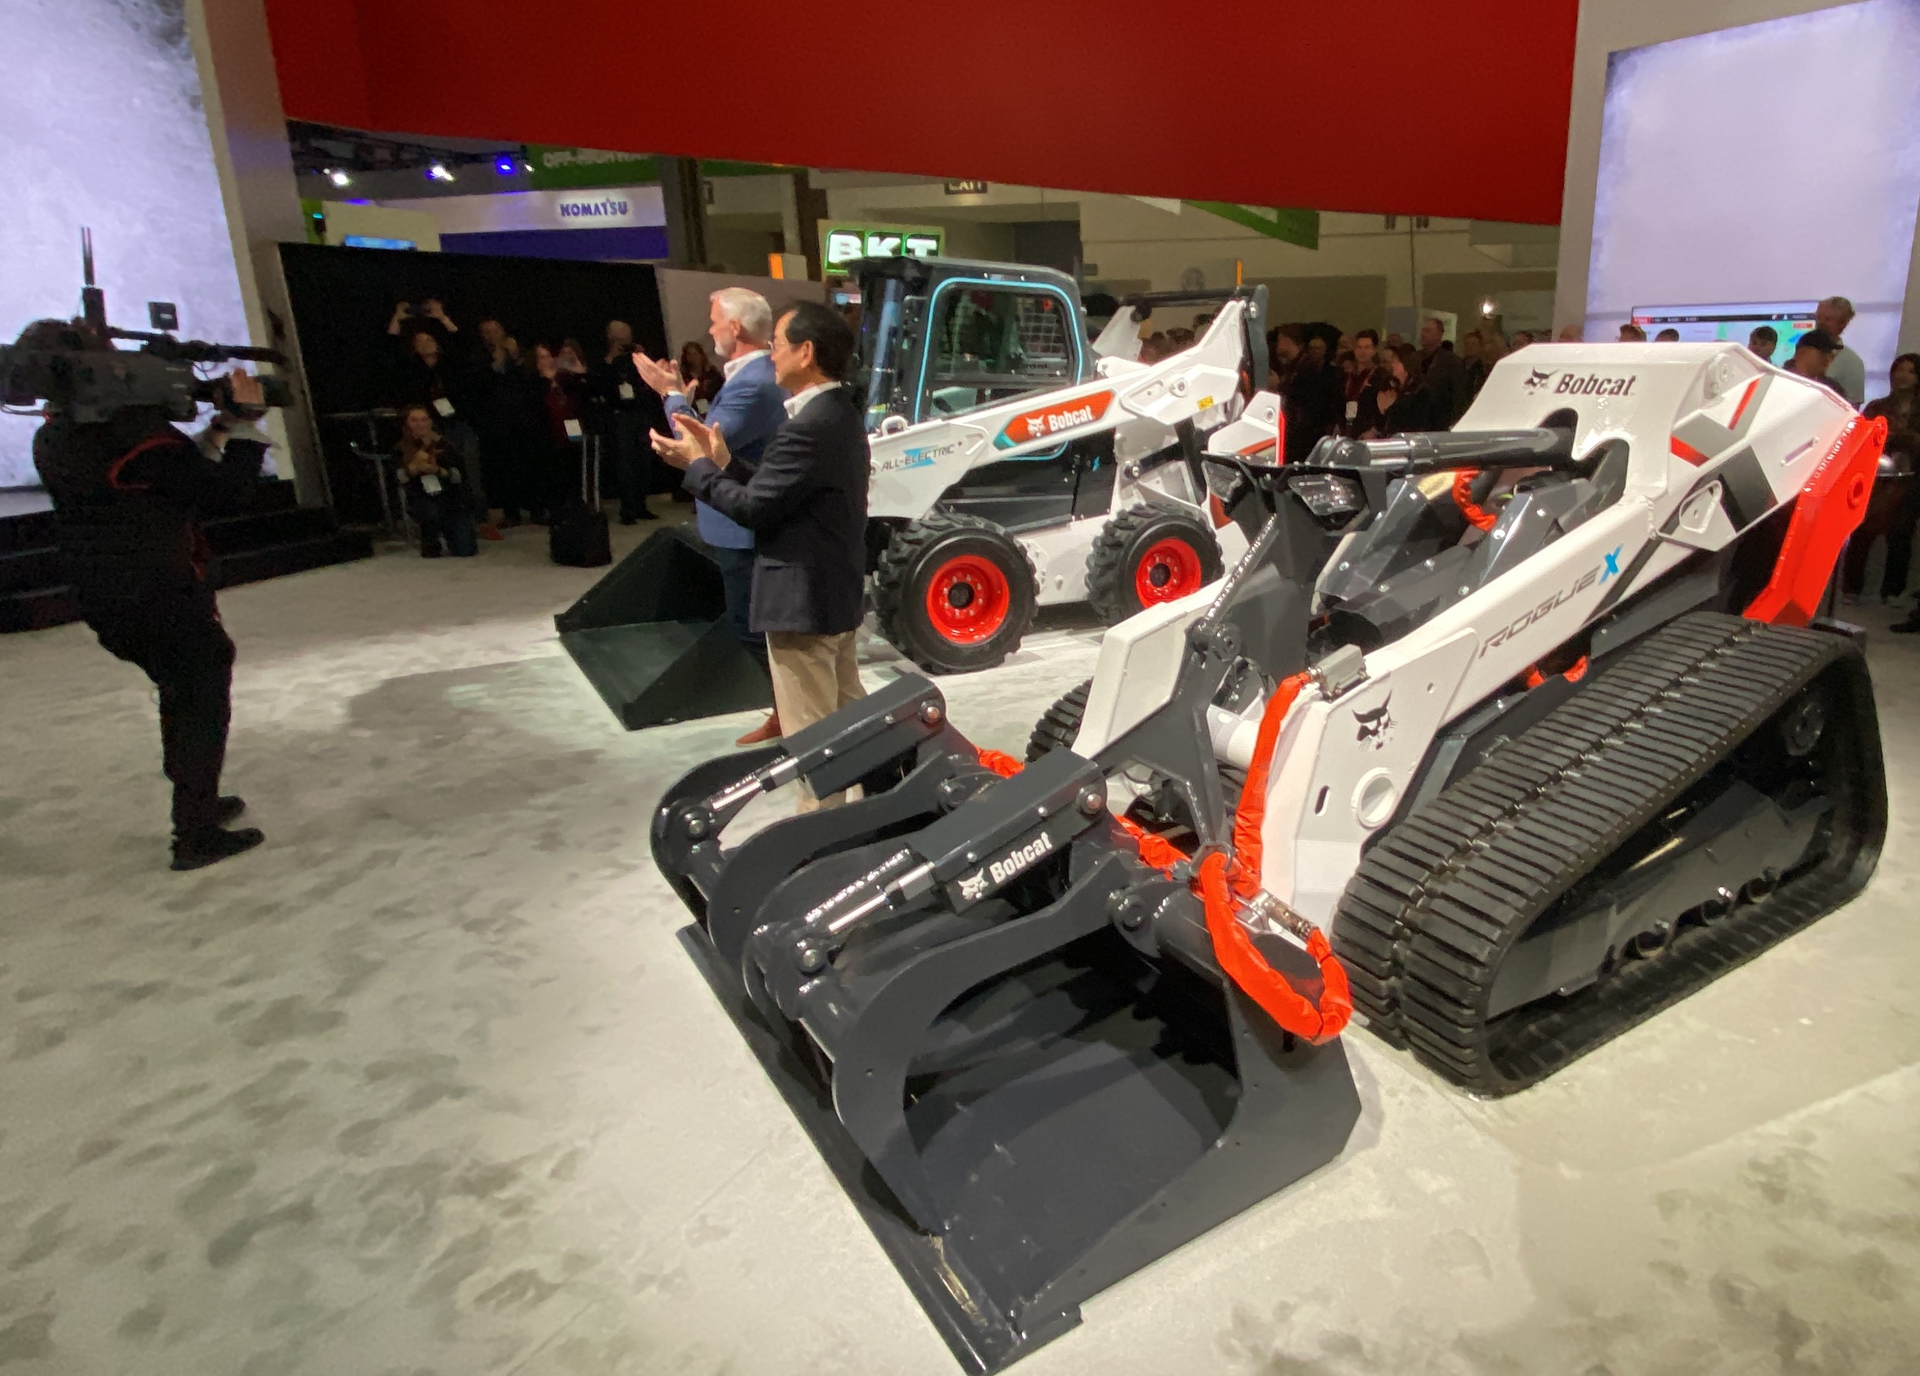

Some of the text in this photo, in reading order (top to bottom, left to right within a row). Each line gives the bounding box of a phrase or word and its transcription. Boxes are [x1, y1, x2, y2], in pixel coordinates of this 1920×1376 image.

[560, 198, 628, 217] KOMATSU
[828, 234, 938, 263] BKT
[1554, 373, 1636, 396] Bobcat
[1047, 404, 1094, 432] Bobcat
[881, 443, 955, 472] ALL-ELECTRIC
[989, 831, 1053, 885] Bobcat
